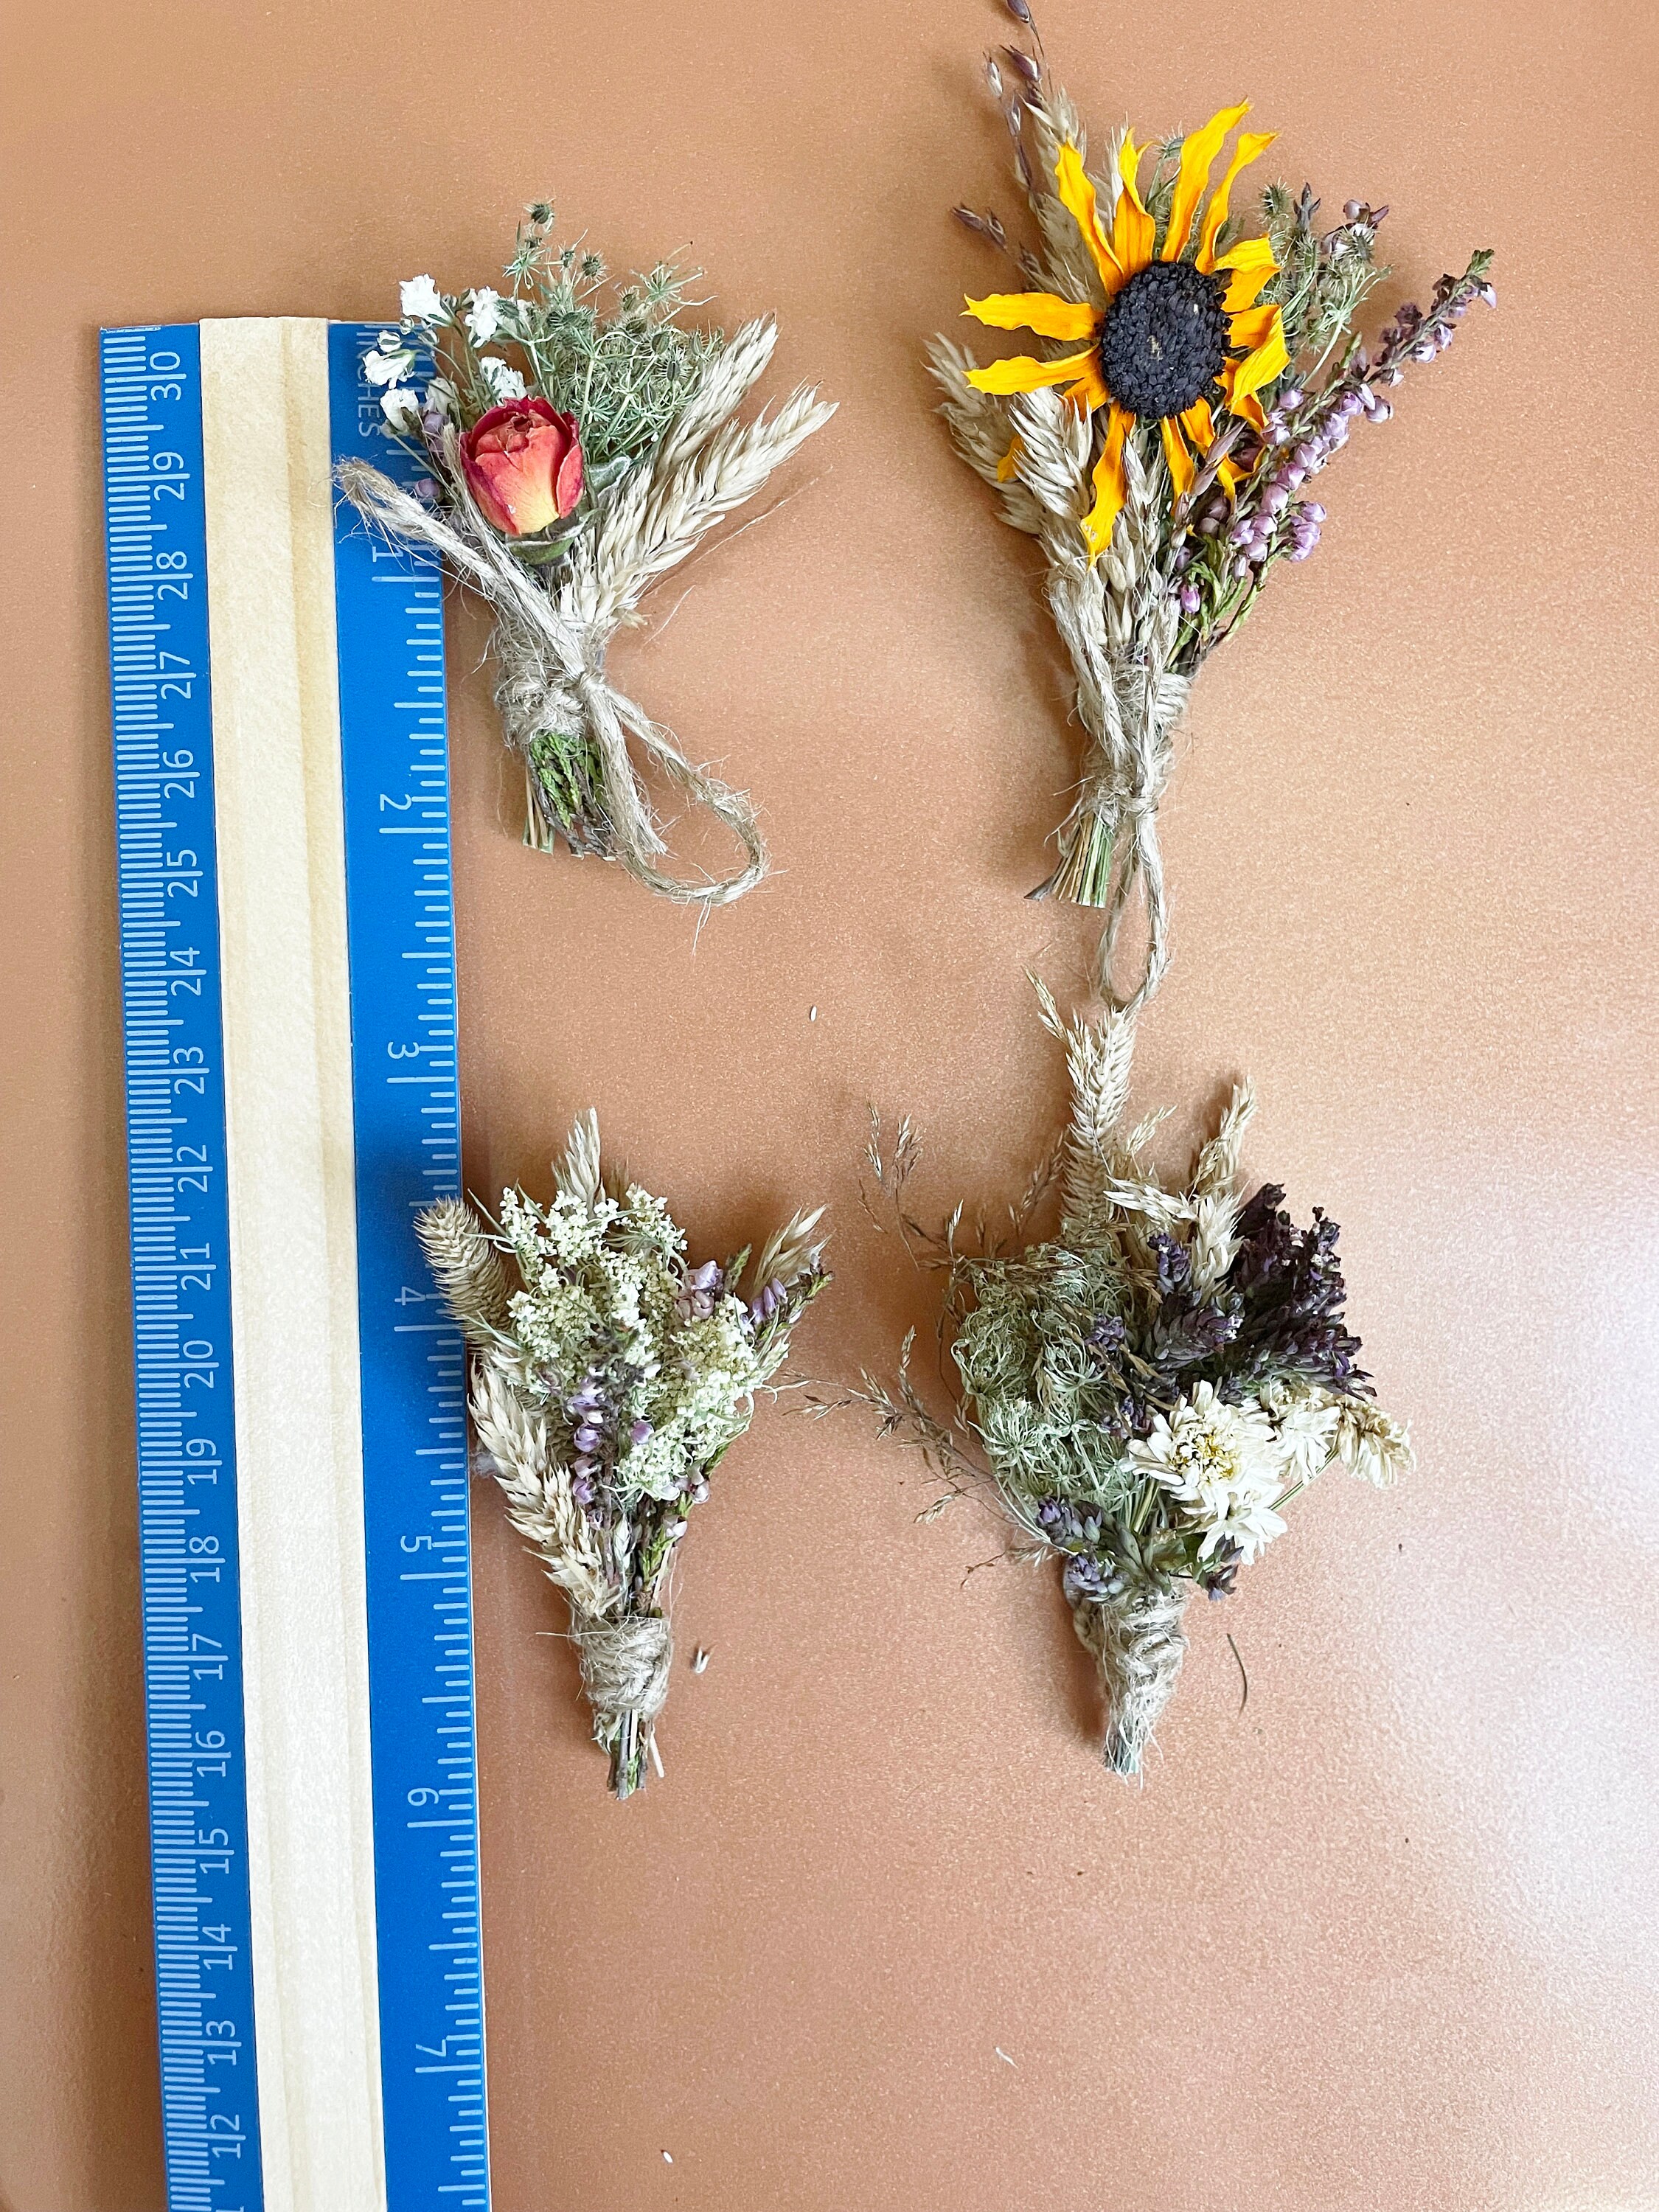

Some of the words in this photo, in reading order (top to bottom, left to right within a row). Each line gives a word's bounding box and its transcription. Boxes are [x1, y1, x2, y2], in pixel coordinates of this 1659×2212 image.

[149, 351, 181, 400] 30
[153, 451, 184, 501] 29
[156, 551, 188, 600] 28
[372, 546, 403, 563] 1
[159, 651, 191, 700] 27
[162, 749, 195, 799] 26
[379, 793, 412, 811] 2
[166, 849, 198, 897] 25
[170, 947, 201, 996] 24
[173, 1046, 205, 1094] 23
[387, 1041, 420, 1059] 3
[176, 1144, 207, 1193] 22
[180, 1242, 211, 1290] 21
[394, 1286, 426, 1306] 4
[183, 1340, 214, 1388] 20
[186, 1439, 218, 1485] 19
[189, 1535, 220, 1583] 18
[400, 1535, 432, 1553] 5
[192, 1633, 223, 1680] 17
[195, 1730, 226, 1777] 16
[407, 1787, 439, 1806] 6
[198, 1828, 229, 1874] 15
[202, 1924, 233, 1970] 14
[205, 2020, 236, 2065] 13
[415, 2039, 447, 2056] 7
[209, 2114, 241, 2159] 12
